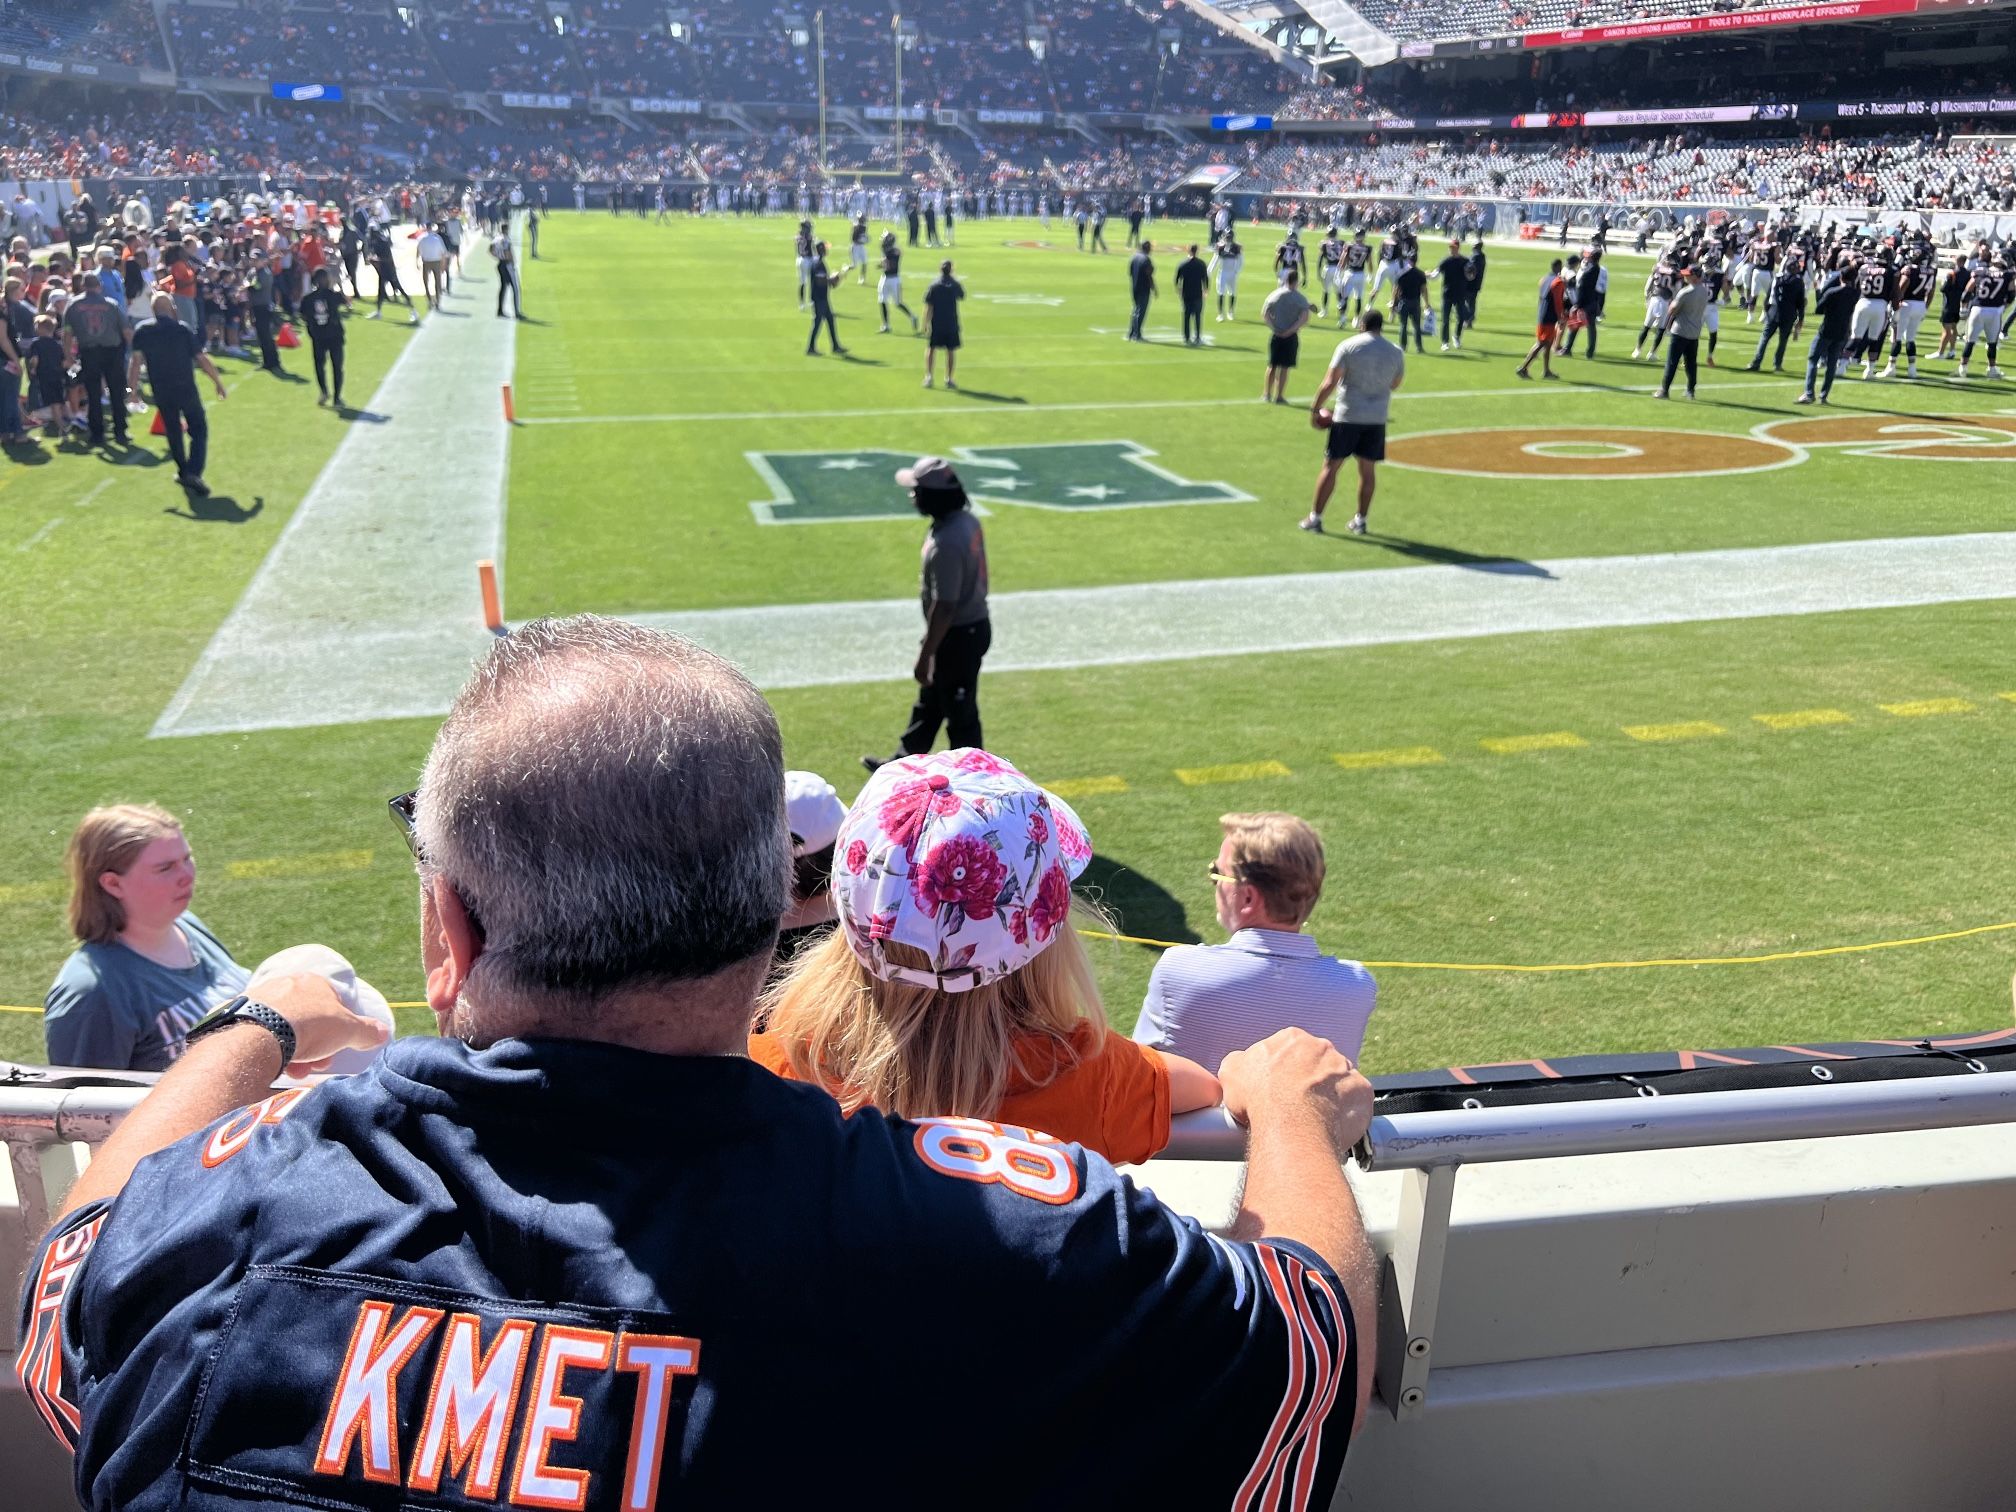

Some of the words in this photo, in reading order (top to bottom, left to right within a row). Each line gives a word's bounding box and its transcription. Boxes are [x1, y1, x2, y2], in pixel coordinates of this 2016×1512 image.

[1708, 17, 1731, 27] TOOLS
[1733, 15, 1743, 25] TO
[1744, 13, 1770, 24] TACKLE
[1771, 9, 1815, 21] WORKPLACE
[1816, 4, 1861, 17] EFFICIENCY
[1603, 27, 1626, 37] CANON
[1627, 24, 1661, 35] SOLUTIONS
[1662, 21, 1692, 32] AMERICA
[503, 94, 571, 109] BEAR
[631, 98, 701, 113] DOWN
[1858, 103, 1865, 116] 5
[864, 107, 927, 120] BEAR
[977, 110, 1043, 123] DOWN
[1978, 277, 2005, 299] 67
[314, 1299, 701, 1512] KMET
